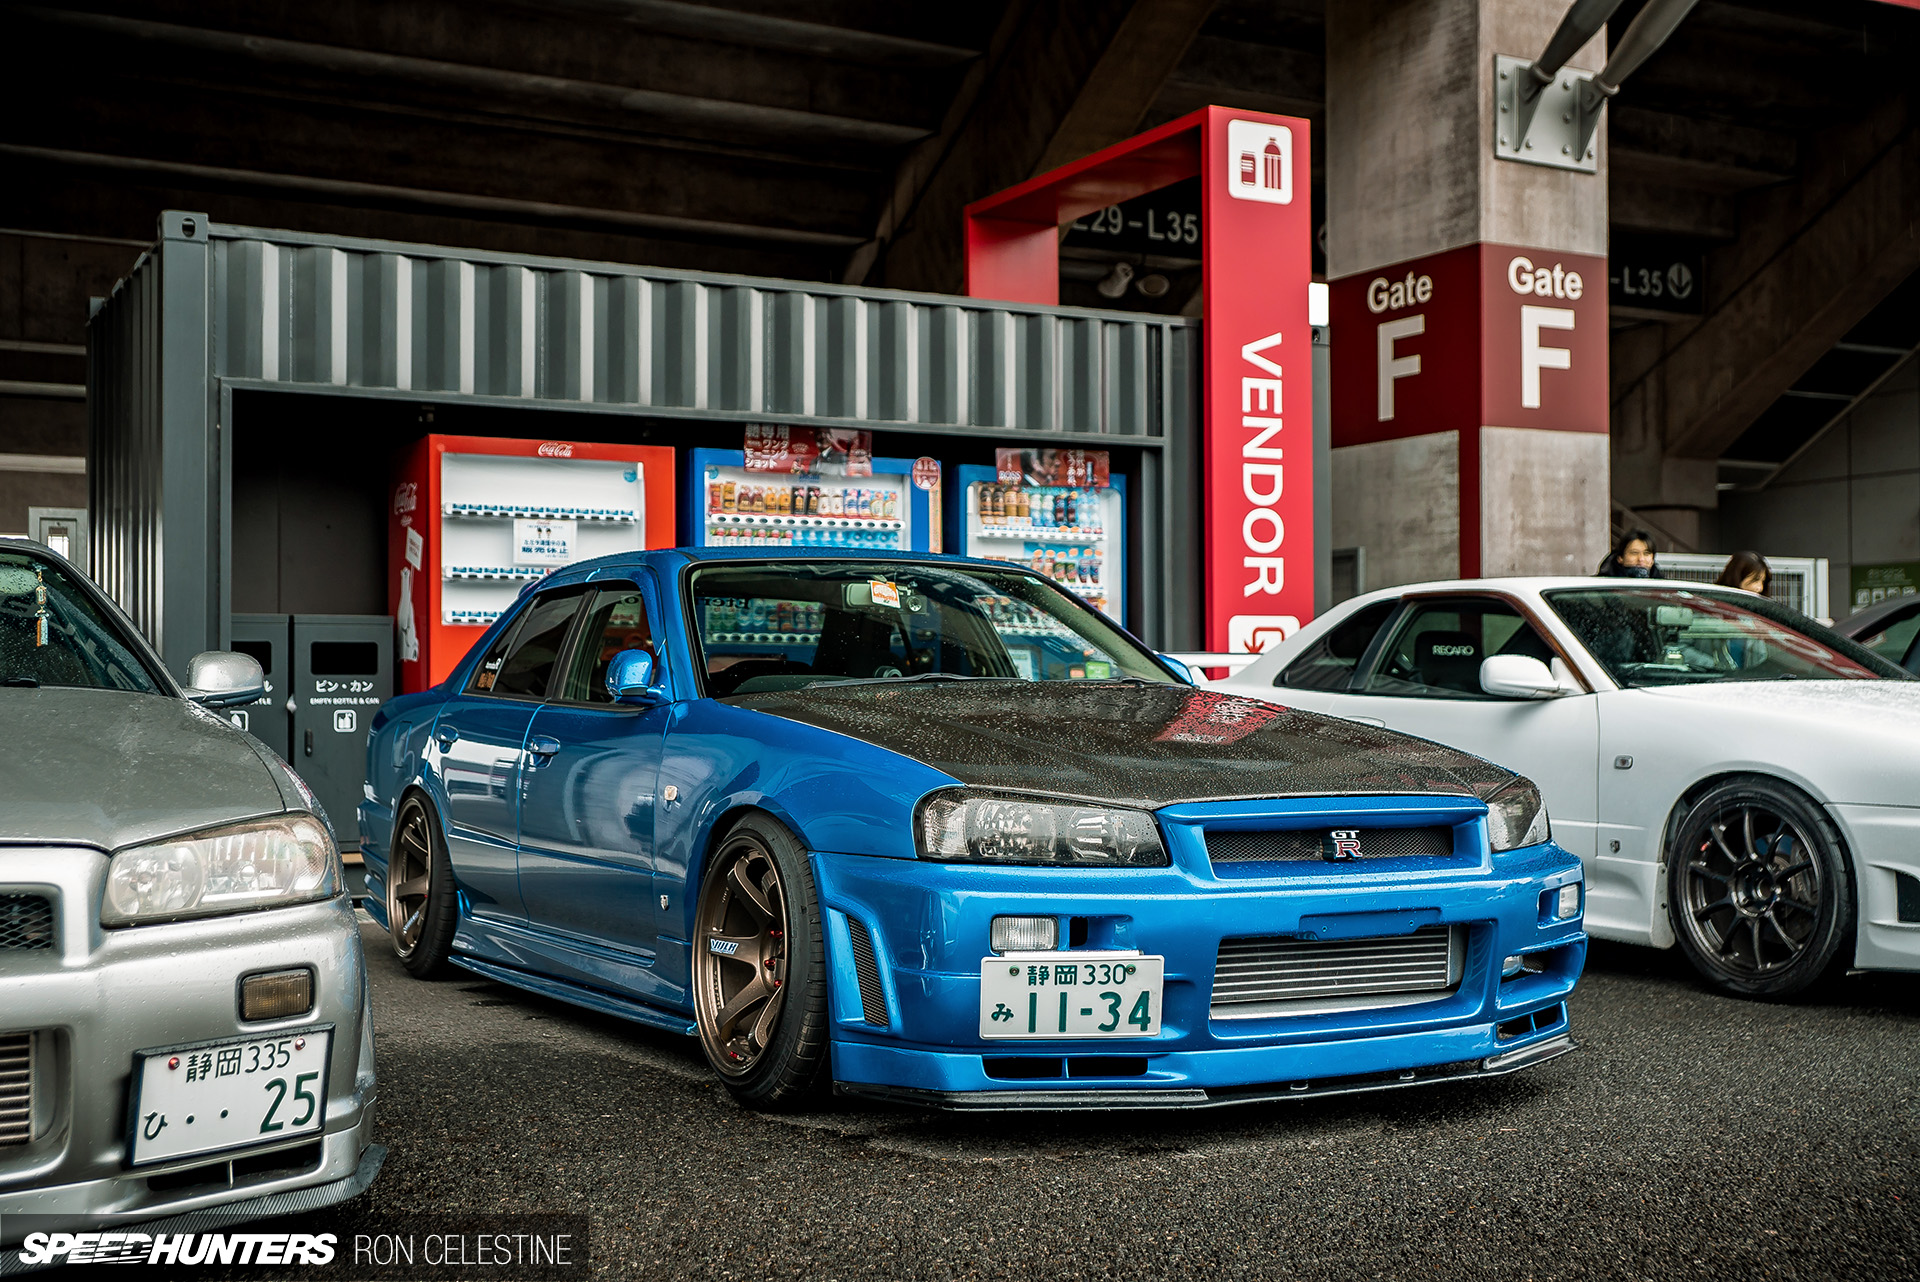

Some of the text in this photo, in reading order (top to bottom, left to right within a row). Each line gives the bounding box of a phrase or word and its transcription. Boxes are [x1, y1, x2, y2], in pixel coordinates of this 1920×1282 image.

[1367, 270, 1433, 314] Gate
[1507, 256, 1584, 300] Gate
[1376, 313, 1426, 423] F
[1520, 304, 1576, 410] F
[1241, 331, 1285, 598] VENDOR
[1432, 644, 1475, 656] RECARO
[310, 697, 332, 705] EMPTY
[333, 697, 358, 705] BOTTLE
[365, 697, 380, 705] CAN
[1331, 830, 1360, 839] GT
[1334, 839, 1363, 858] R
[991, 991, 1151, 1033] み 11-34
[144, 1111, 169, 1140] ひ
[259, 1071, 319, 1134] 25
